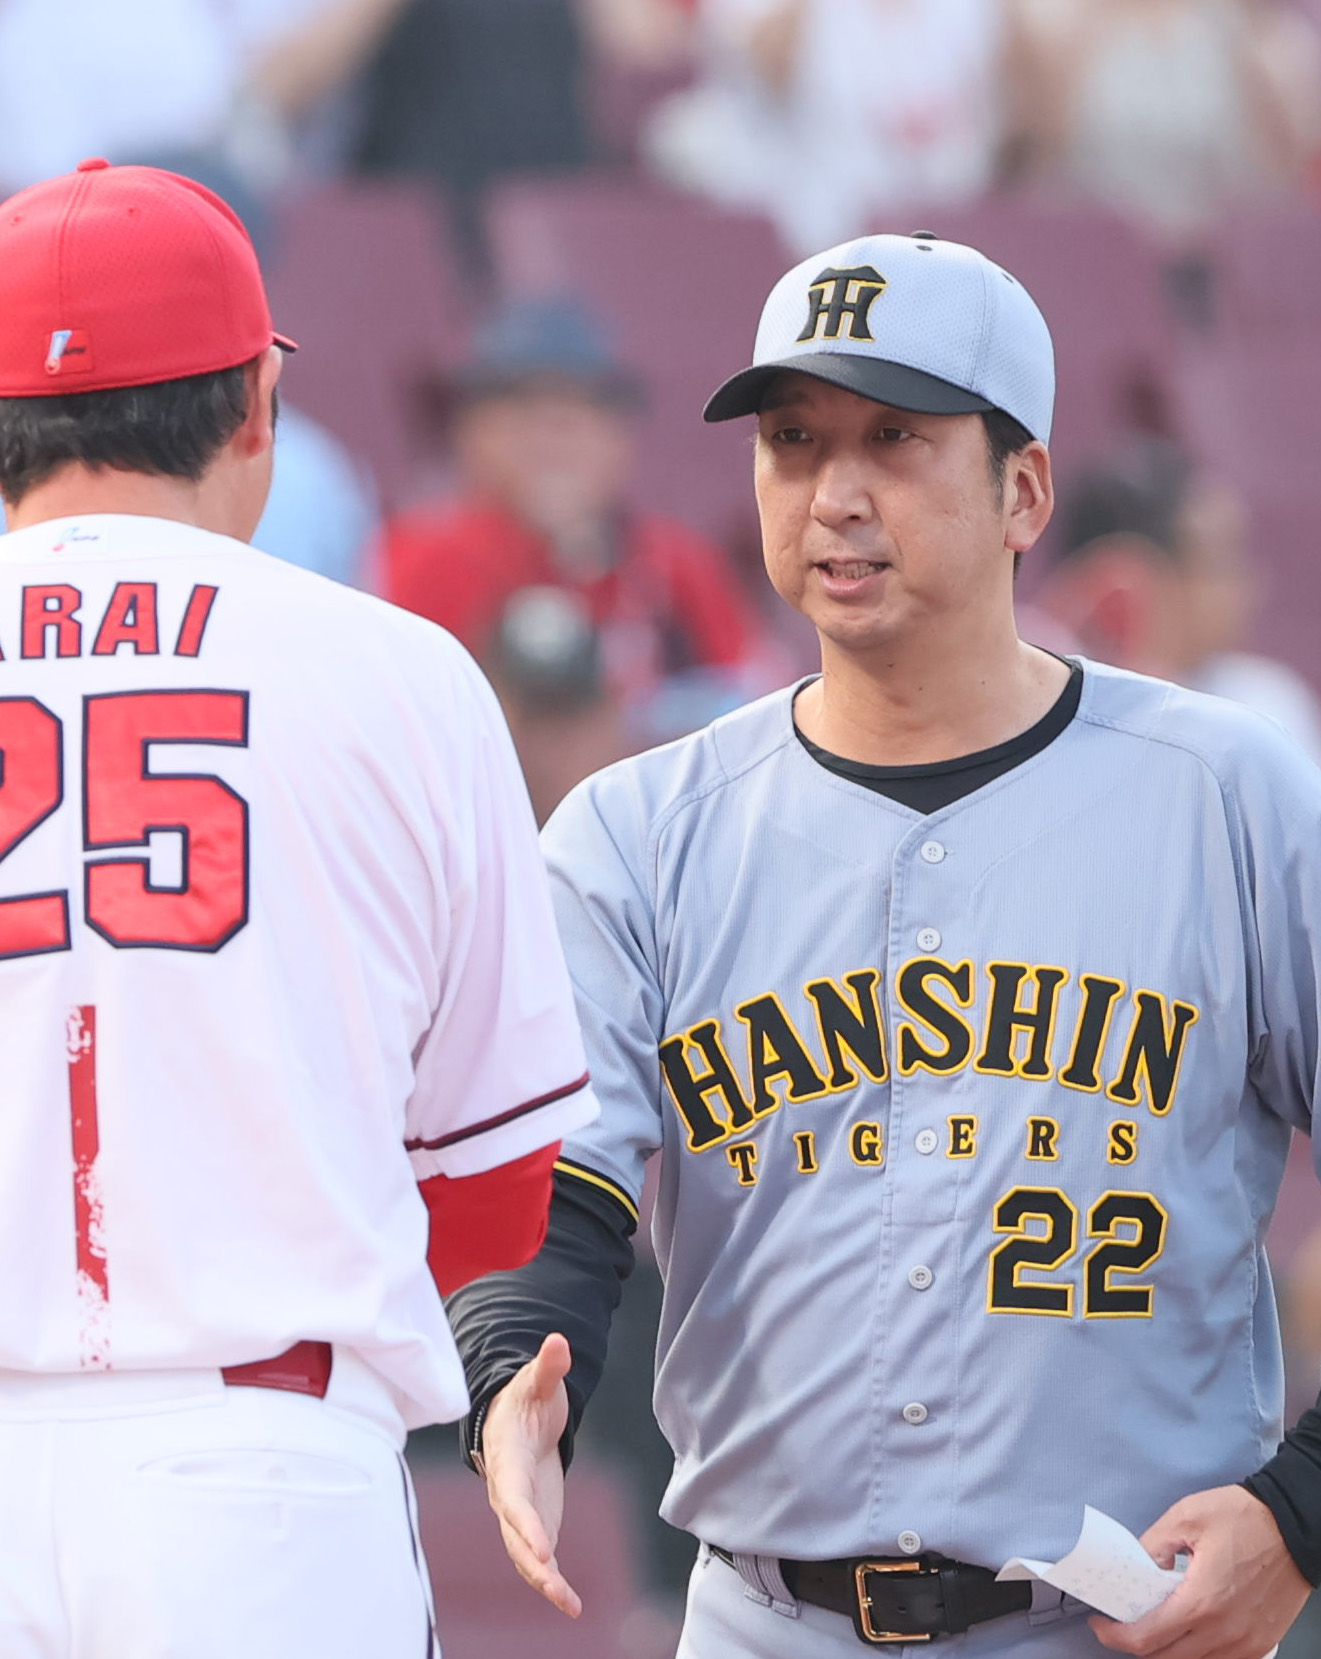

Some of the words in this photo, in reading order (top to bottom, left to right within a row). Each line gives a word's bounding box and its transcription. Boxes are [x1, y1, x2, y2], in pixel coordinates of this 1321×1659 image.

[657, 956, 1200, 1154] HANSHIN
[726, 1115, 1137, 1186] TIGERS
[986, 1185, 1168, 1318] 22
